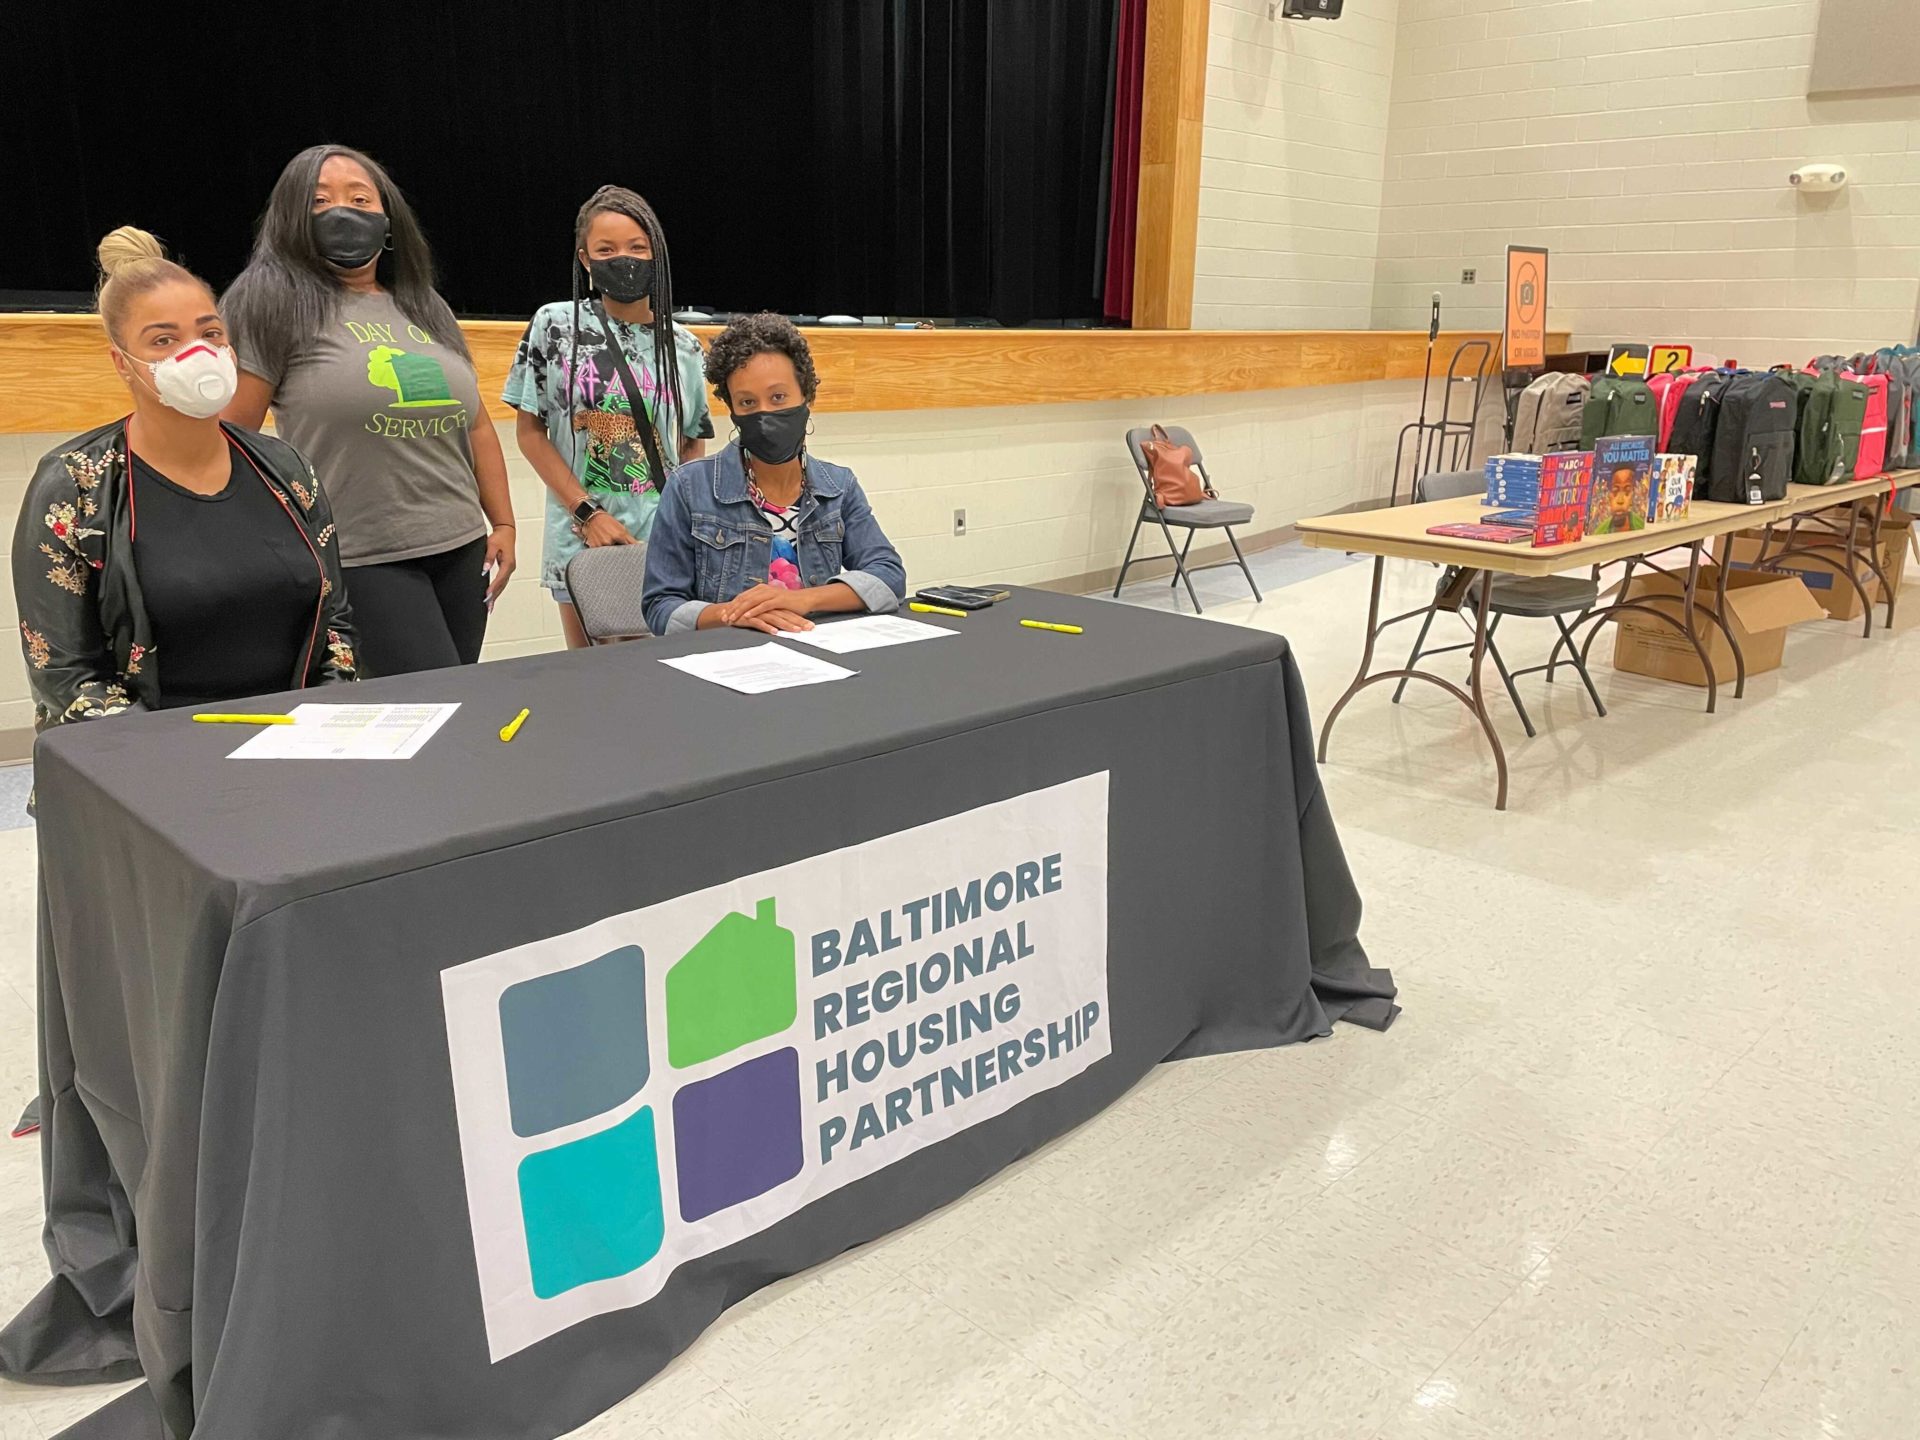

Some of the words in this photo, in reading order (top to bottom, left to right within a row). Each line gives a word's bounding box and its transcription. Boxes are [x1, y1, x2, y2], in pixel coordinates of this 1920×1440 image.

[345, 321, 398, 344] DAY
[1665, 351, 1680, 373] 2
[365, 409, 466, 438] SERVICE
[1603, 451, 1619, 463] YOU
[1620, 449, 1649, 462] MATTER
[1556, 470, 1583, 488] BLACK
[1548, 487, 1582, 506] HISTORY
[811, 852, 1062, 978] BALTIMORE
[813, 920, 1035, 1041] REGIONAL
[815, 983, 1021, 1103] HOUSING
[819, 1001, 1100, 1166] PARTNERSHIP
